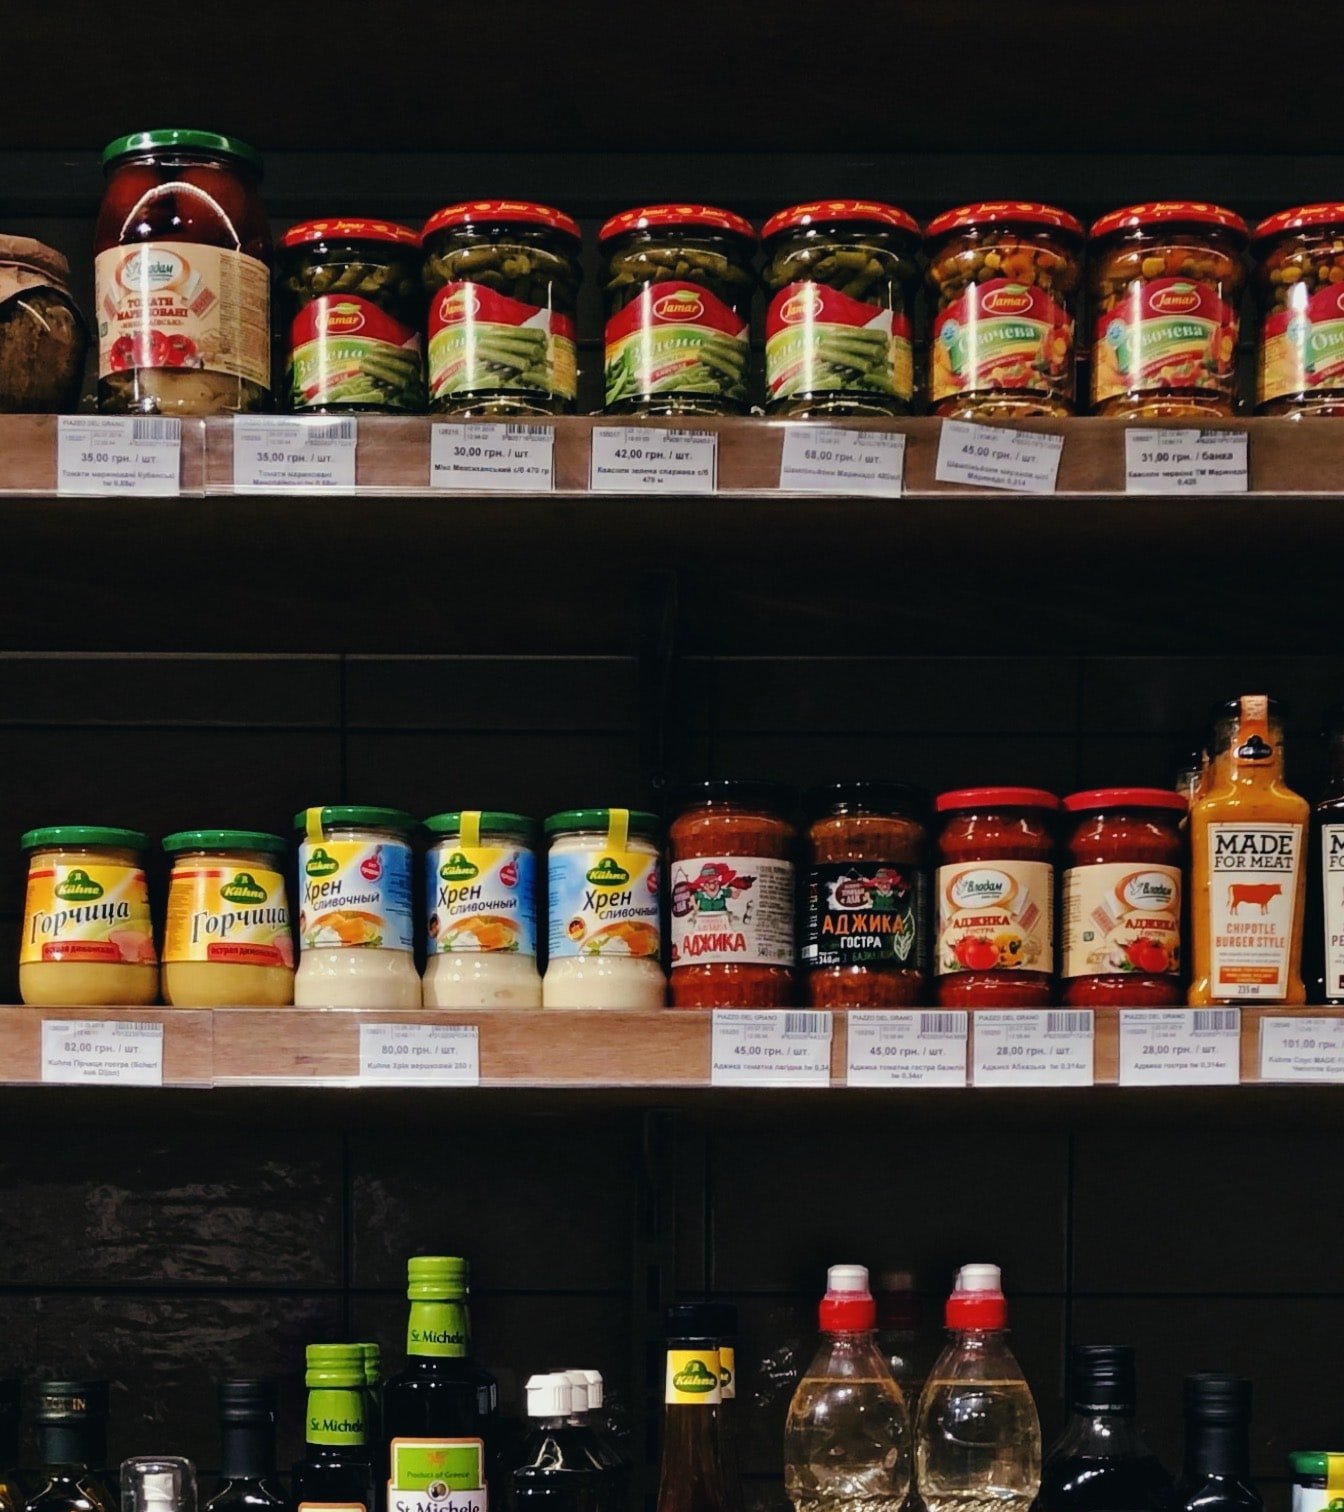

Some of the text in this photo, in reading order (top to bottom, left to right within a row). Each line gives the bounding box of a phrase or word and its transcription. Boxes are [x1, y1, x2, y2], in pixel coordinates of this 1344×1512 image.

[662, 301, 700, 316] Jamar
[615, 449, 642, 460] 42,00
[645, 450, 665, 462] грн.
[1141, 450, 1233, 464] 31,00 грн. банка
[1215, 835, 1292, 854] MADE
[1215, 857, 1293, 868] FOR MEAT
[56, 886, 100, 897] Kühne
[304, 881, 341, 904] Хрен
[314, 893, 380, 911] сливочный
[193, 907, 287, 942] Горчица
[822, 915, 904, 933] АДЖИКА
[954, 915, 1010, 928] АДЖИКА
[1227, 923, 1275, 934] CHIPOTLE
[683, 933, 746, 953] АДЖИКА
[840, 937, 882, 948] ГОСТРА
[1216, 936, 1285, 948] BURGER STYLE
[734, 1047, 760, 1056] 45,00
[763, 1049, 785, 1058] грн.
